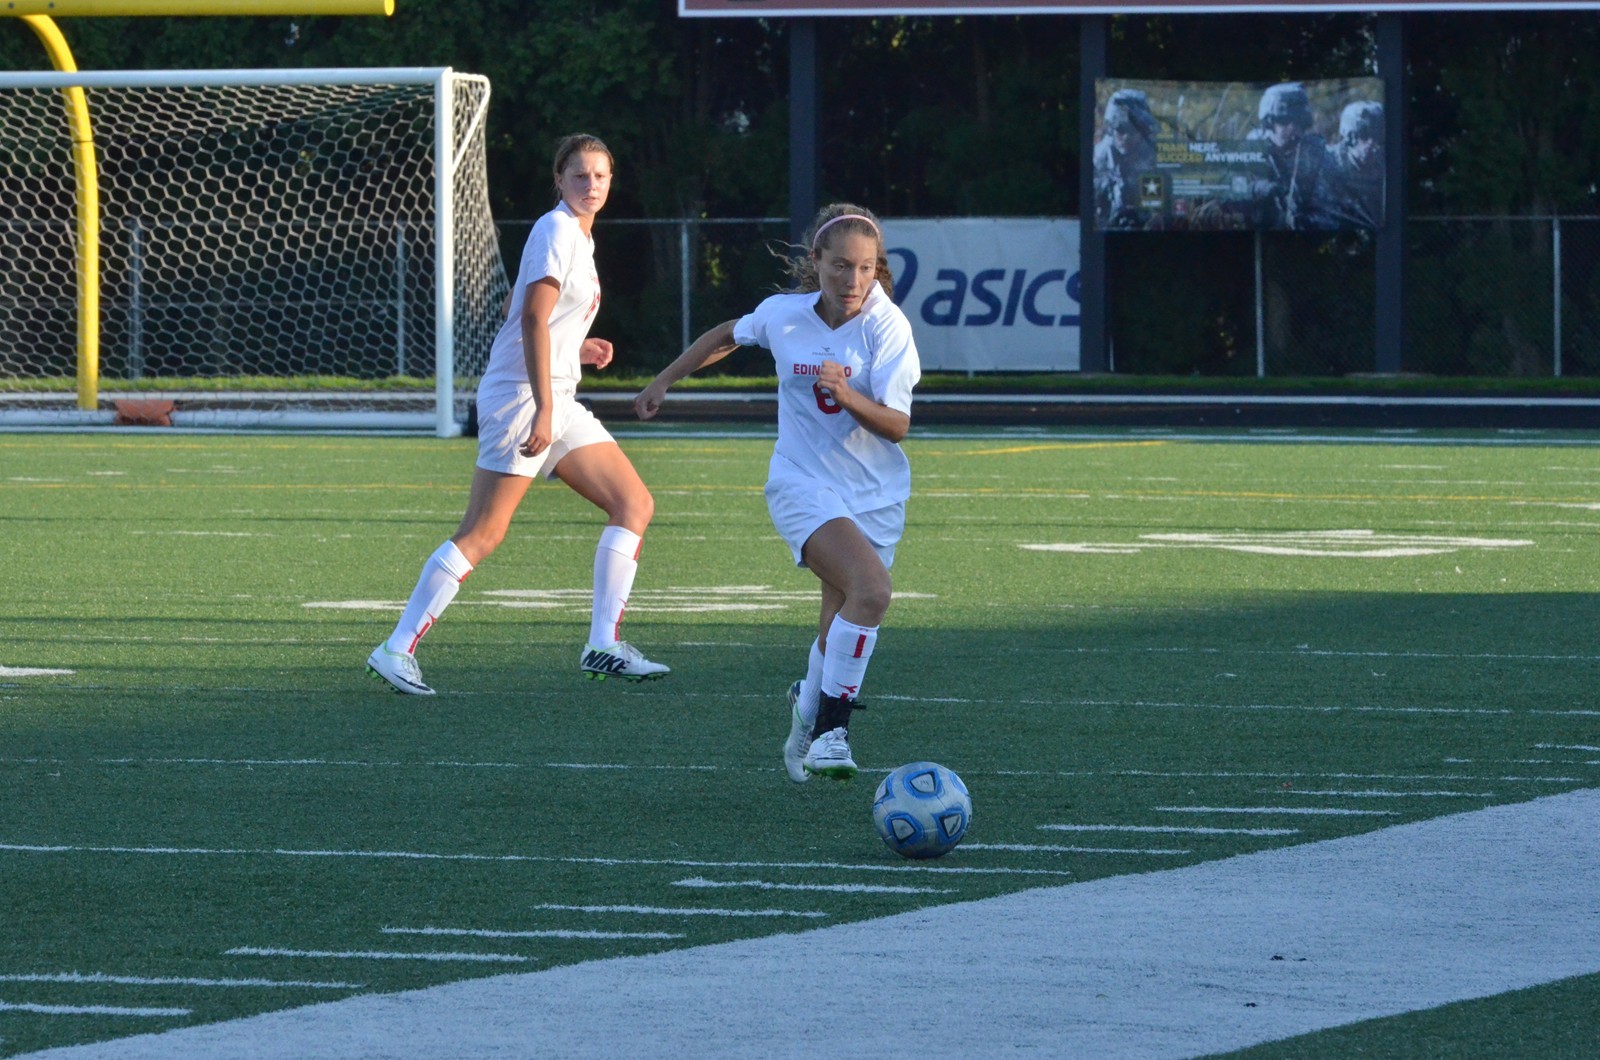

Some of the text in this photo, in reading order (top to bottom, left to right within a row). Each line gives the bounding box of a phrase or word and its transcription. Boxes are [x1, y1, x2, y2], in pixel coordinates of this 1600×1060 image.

[793, 363, 852, 378] EDINO
[812, 381, 843, 415] 6
[582, 649, 631, 674] NIKE
